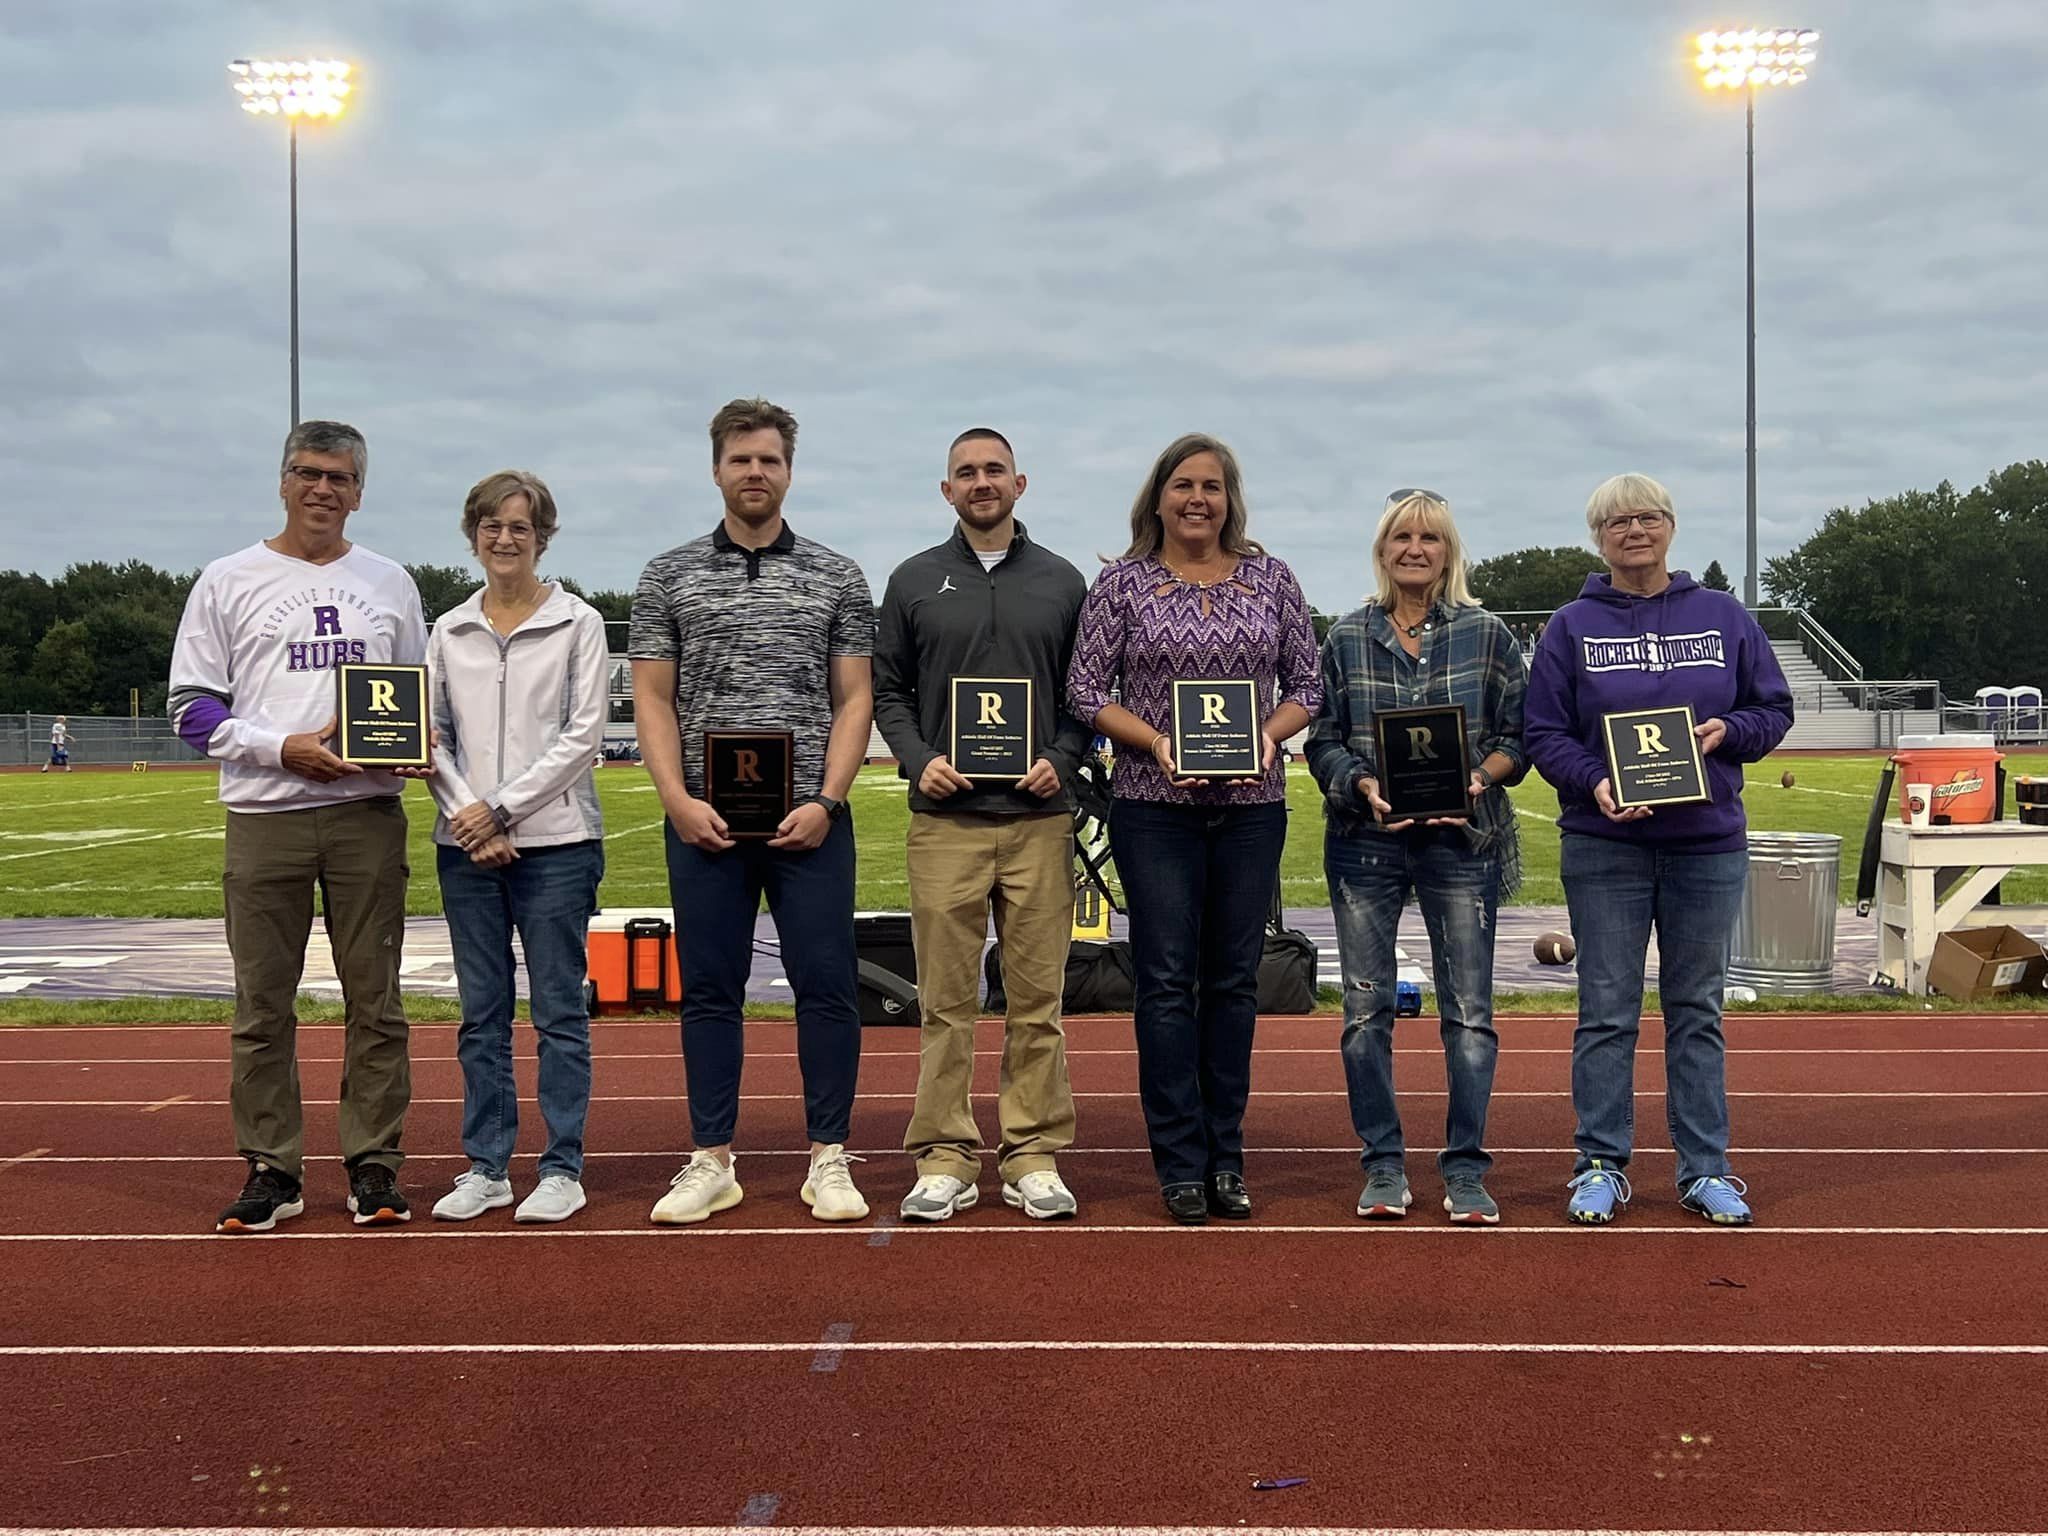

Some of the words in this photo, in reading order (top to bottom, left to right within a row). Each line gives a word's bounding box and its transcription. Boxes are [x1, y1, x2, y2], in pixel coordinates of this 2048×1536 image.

[260, 588, 318, 639] ROCHELLE
[329, 587, 387, 637] TOWNSHIP
[313, 605, 342, 636] R
[287, 638, 367, 672] HUBS
[1584, 641, 1656, 667] ROCHELLE
[367, 679, 401, 712] R
[977, 692, 1007, 725] R
[1199, 693, 1231, 724] R
[1405, 726, 1439, 760] R
[1633, 722, 1670, 755] R
[733, 749, 764, 782] R
[1934, 778, 1984, 798] Gatorade
[1858, 900, 1870, 914] G
